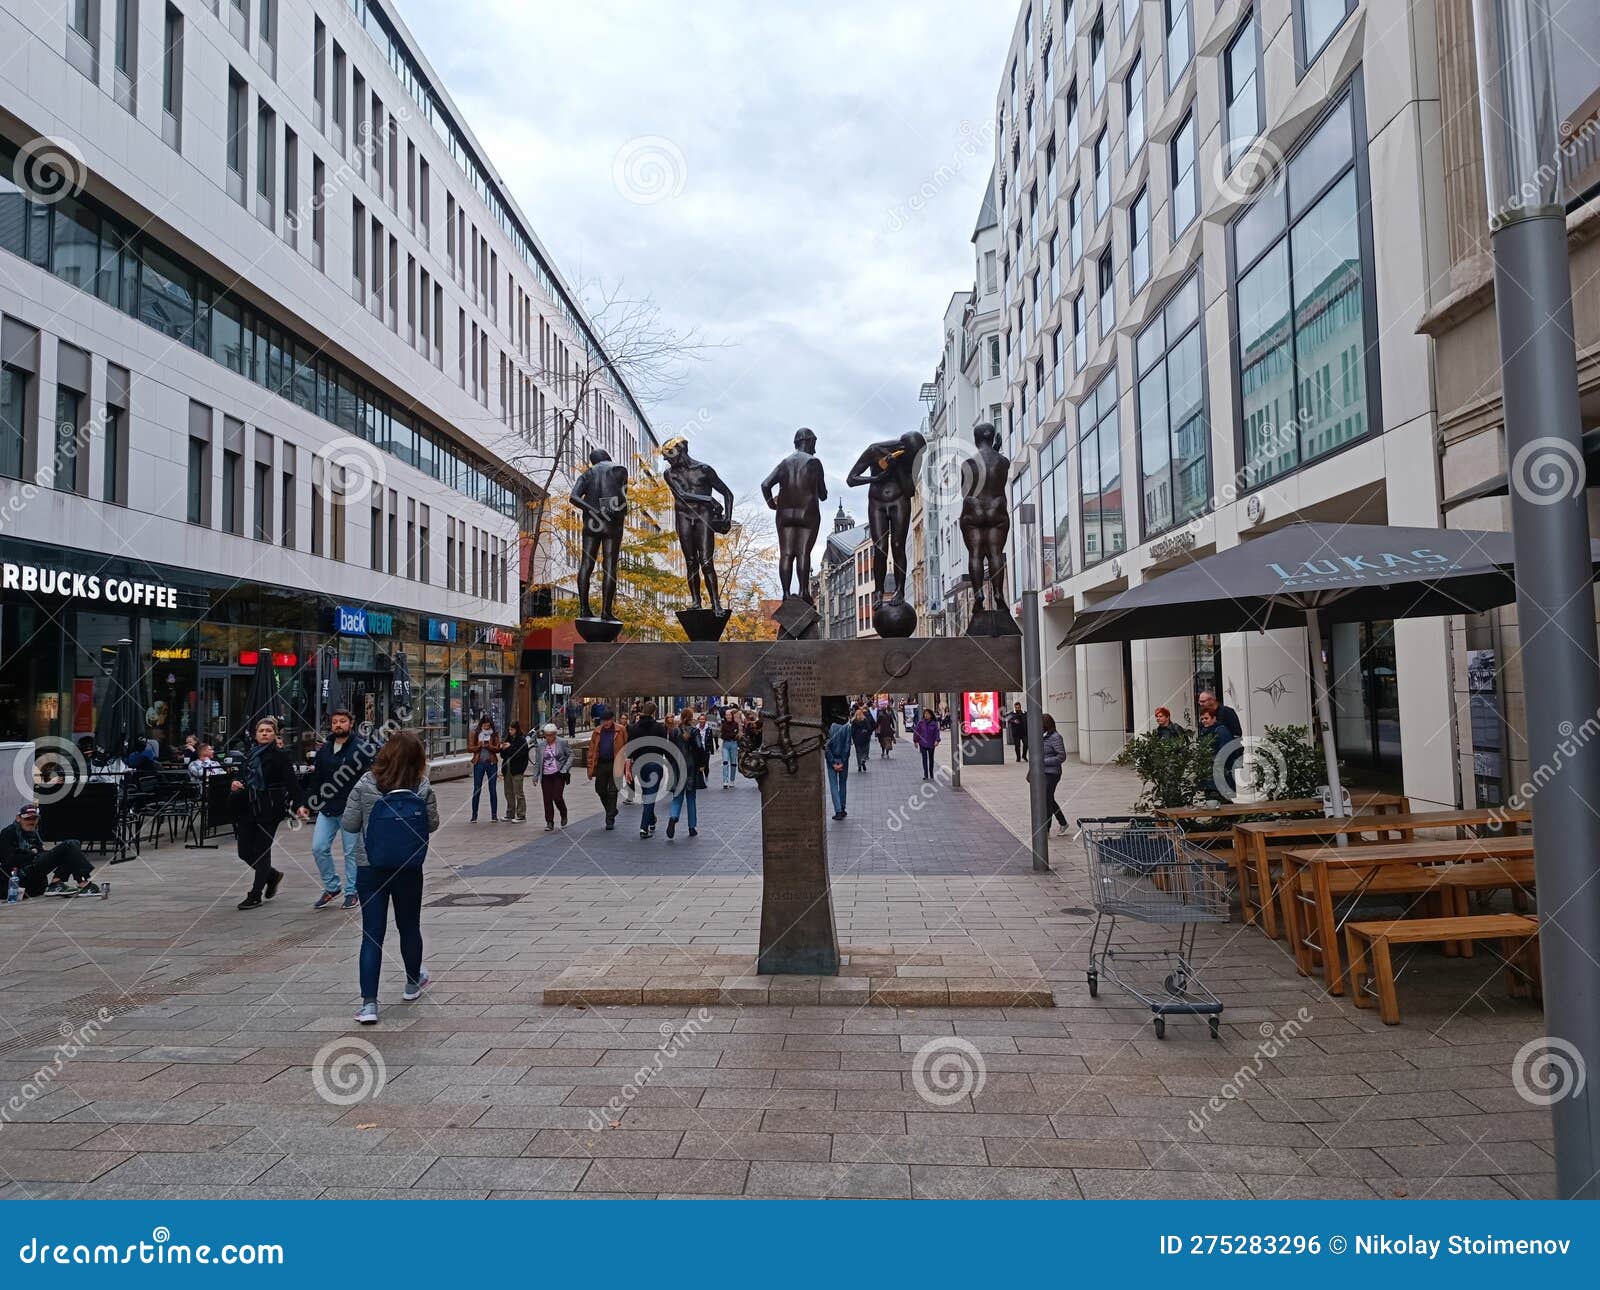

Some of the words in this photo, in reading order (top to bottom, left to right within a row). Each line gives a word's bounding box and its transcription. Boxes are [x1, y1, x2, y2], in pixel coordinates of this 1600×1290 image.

[1266, 549, 1449, 580] LUKAS
[3, 563, 100, 600] RBUCKS
[105, 578, 178, 609] COFFEE
